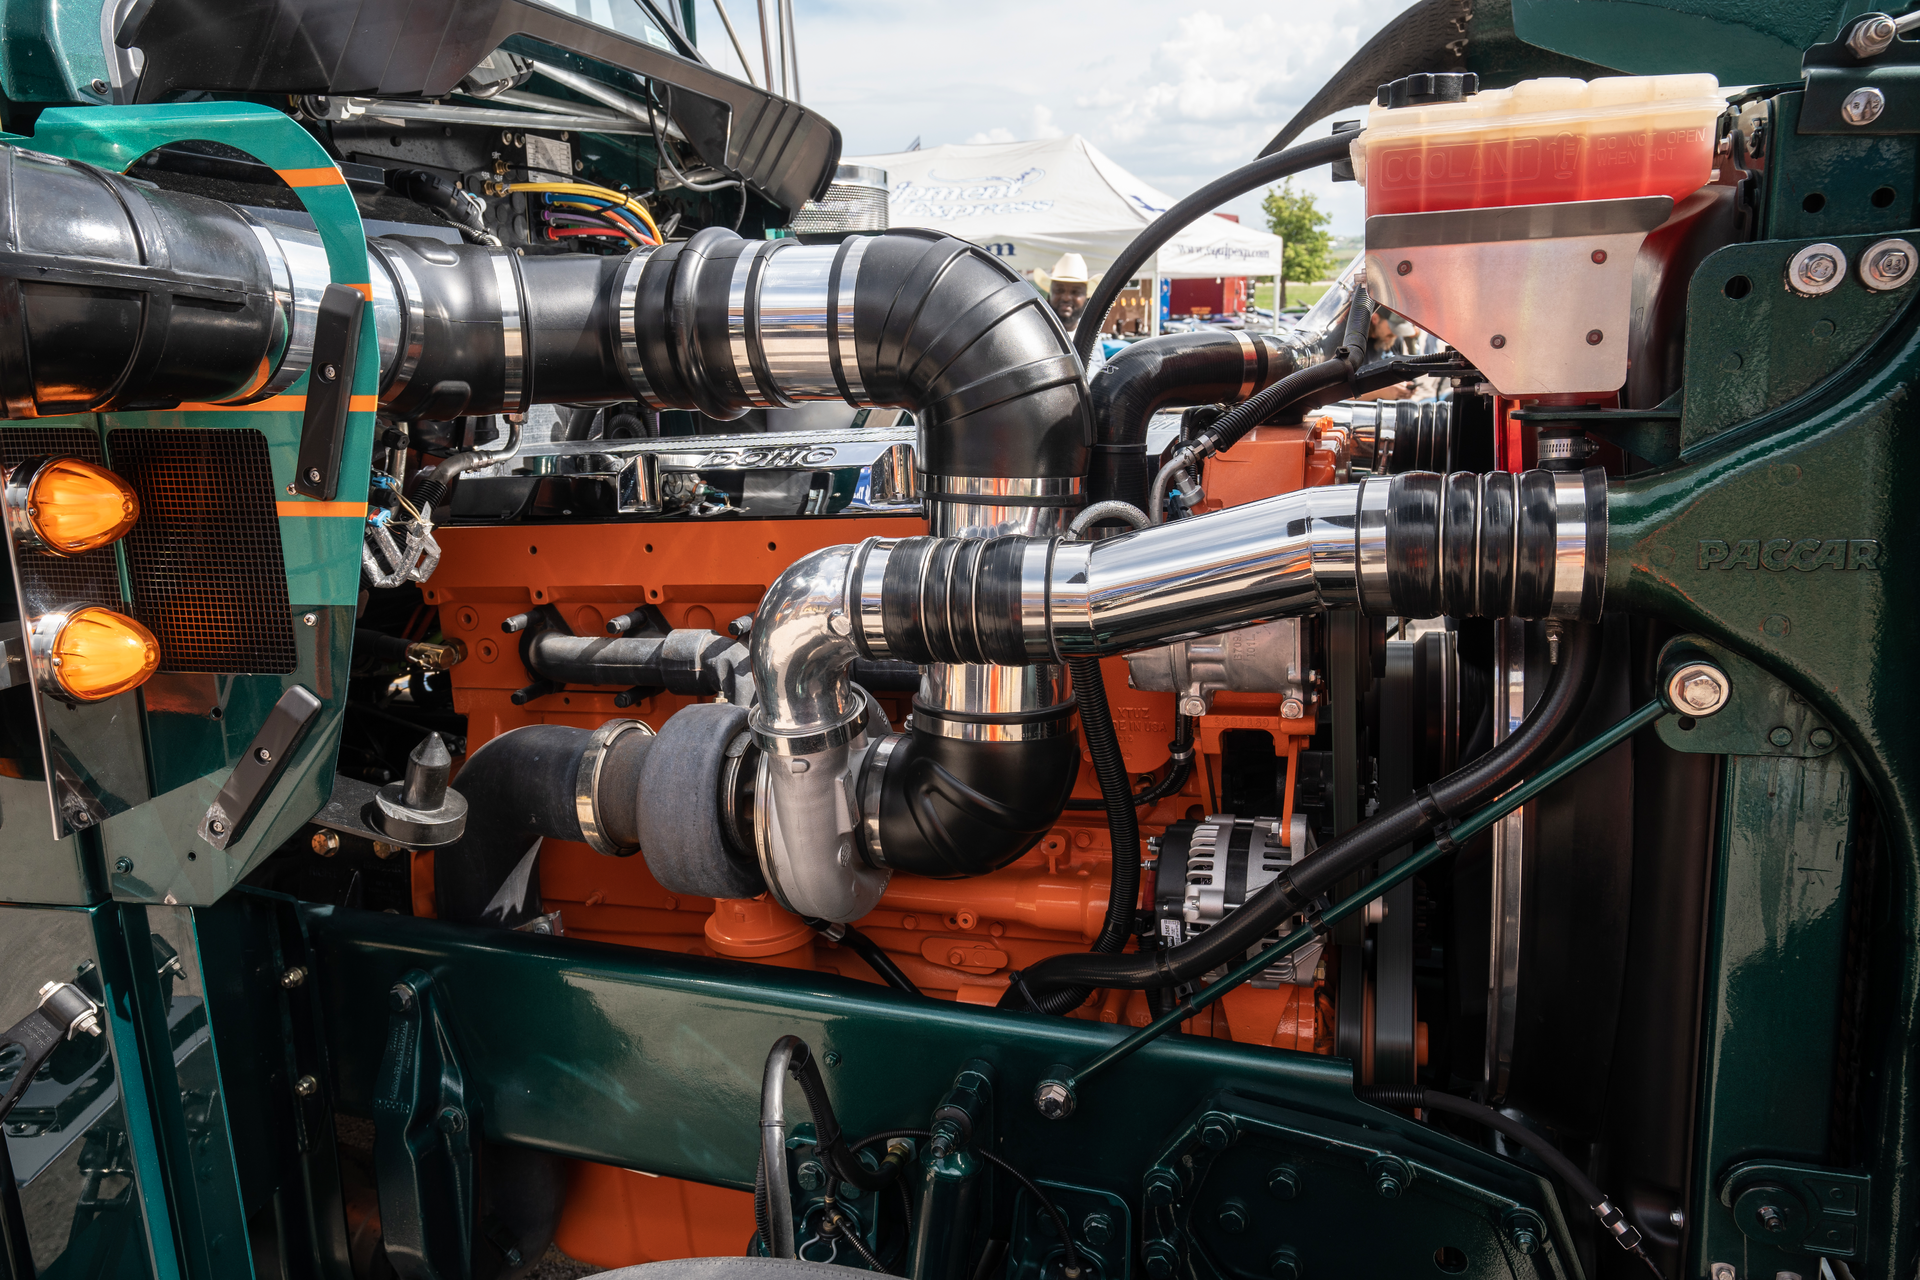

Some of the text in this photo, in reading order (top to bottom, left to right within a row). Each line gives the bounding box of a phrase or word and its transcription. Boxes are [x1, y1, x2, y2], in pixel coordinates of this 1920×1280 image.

[1597, 128, 1707, 151] DO NOT OPEN
[1386, 143, 1532, 183] COOLANT
[1597, 147, 1677, 167] WHEN HOT
[889, 179, 1023, 204] ipment
[898, 199, 1054, 221] Express
[1697, 538, 1882, 572] PACCAR
[1129, 720, 1142, 732] IN
[1144, 721, 1168, 733] USA
